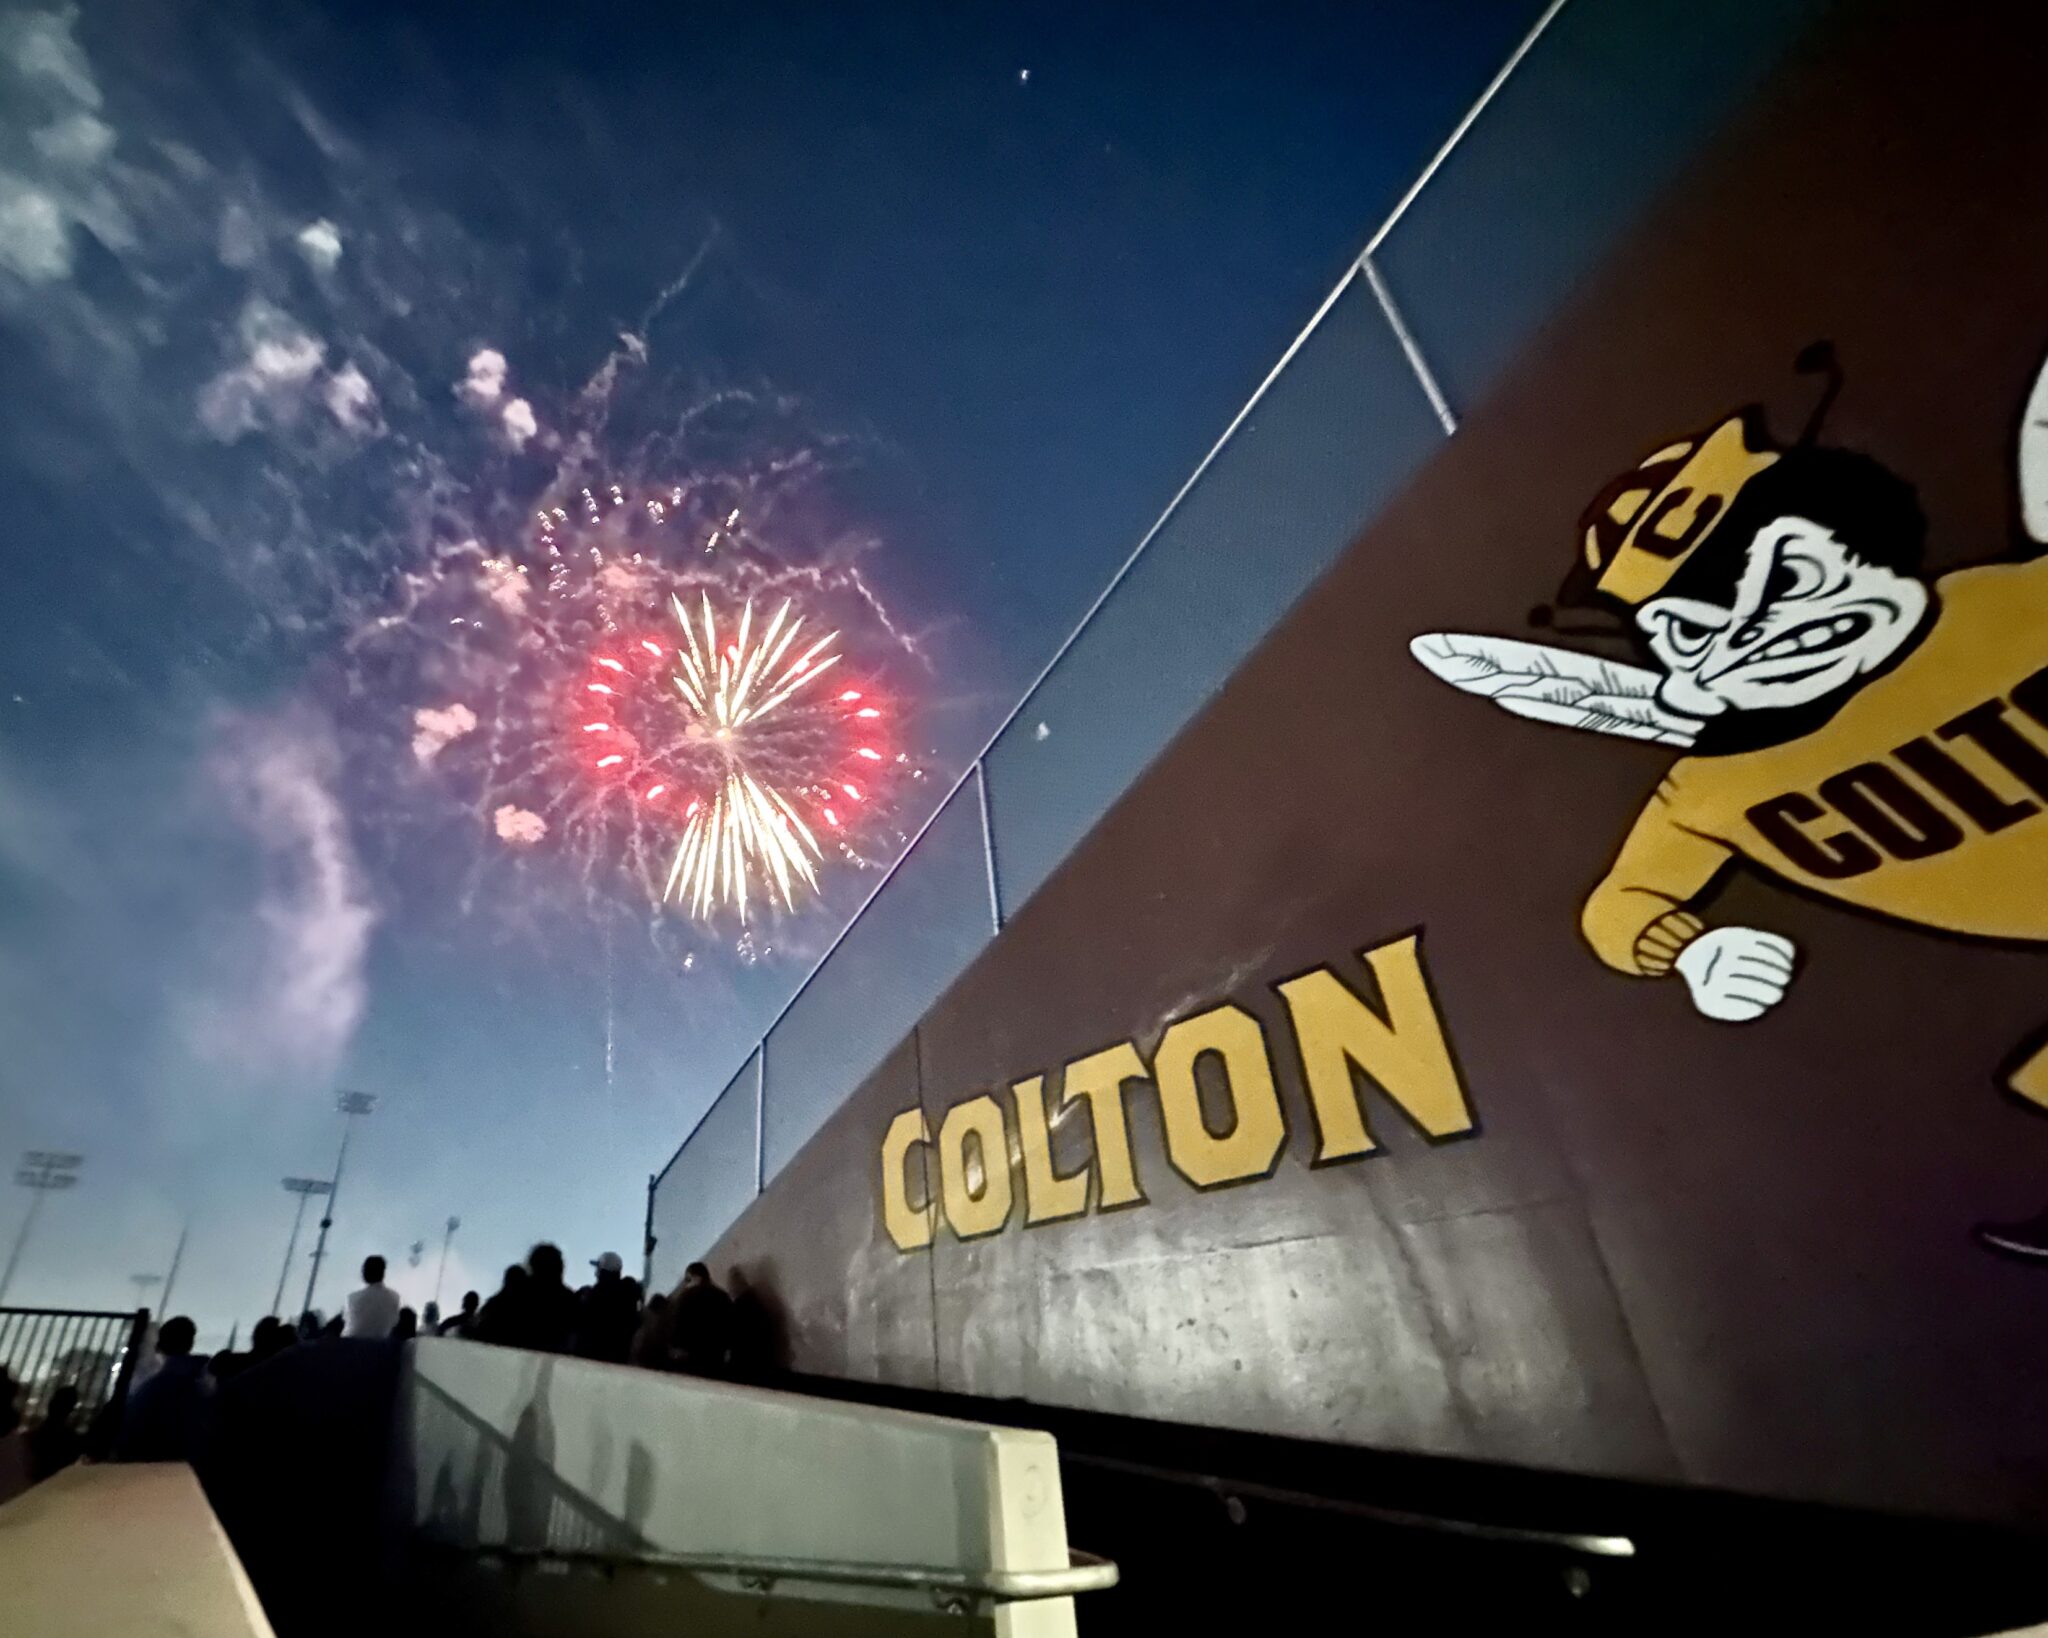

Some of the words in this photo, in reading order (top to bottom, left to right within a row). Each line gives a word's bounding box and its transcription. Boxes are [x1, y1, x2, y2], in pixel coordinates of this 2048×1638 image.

[1632, 486, 1724, 560] C
[1744, 665, 2048, 880] COLT
[878, 925, 1480, 1254] COLTON
